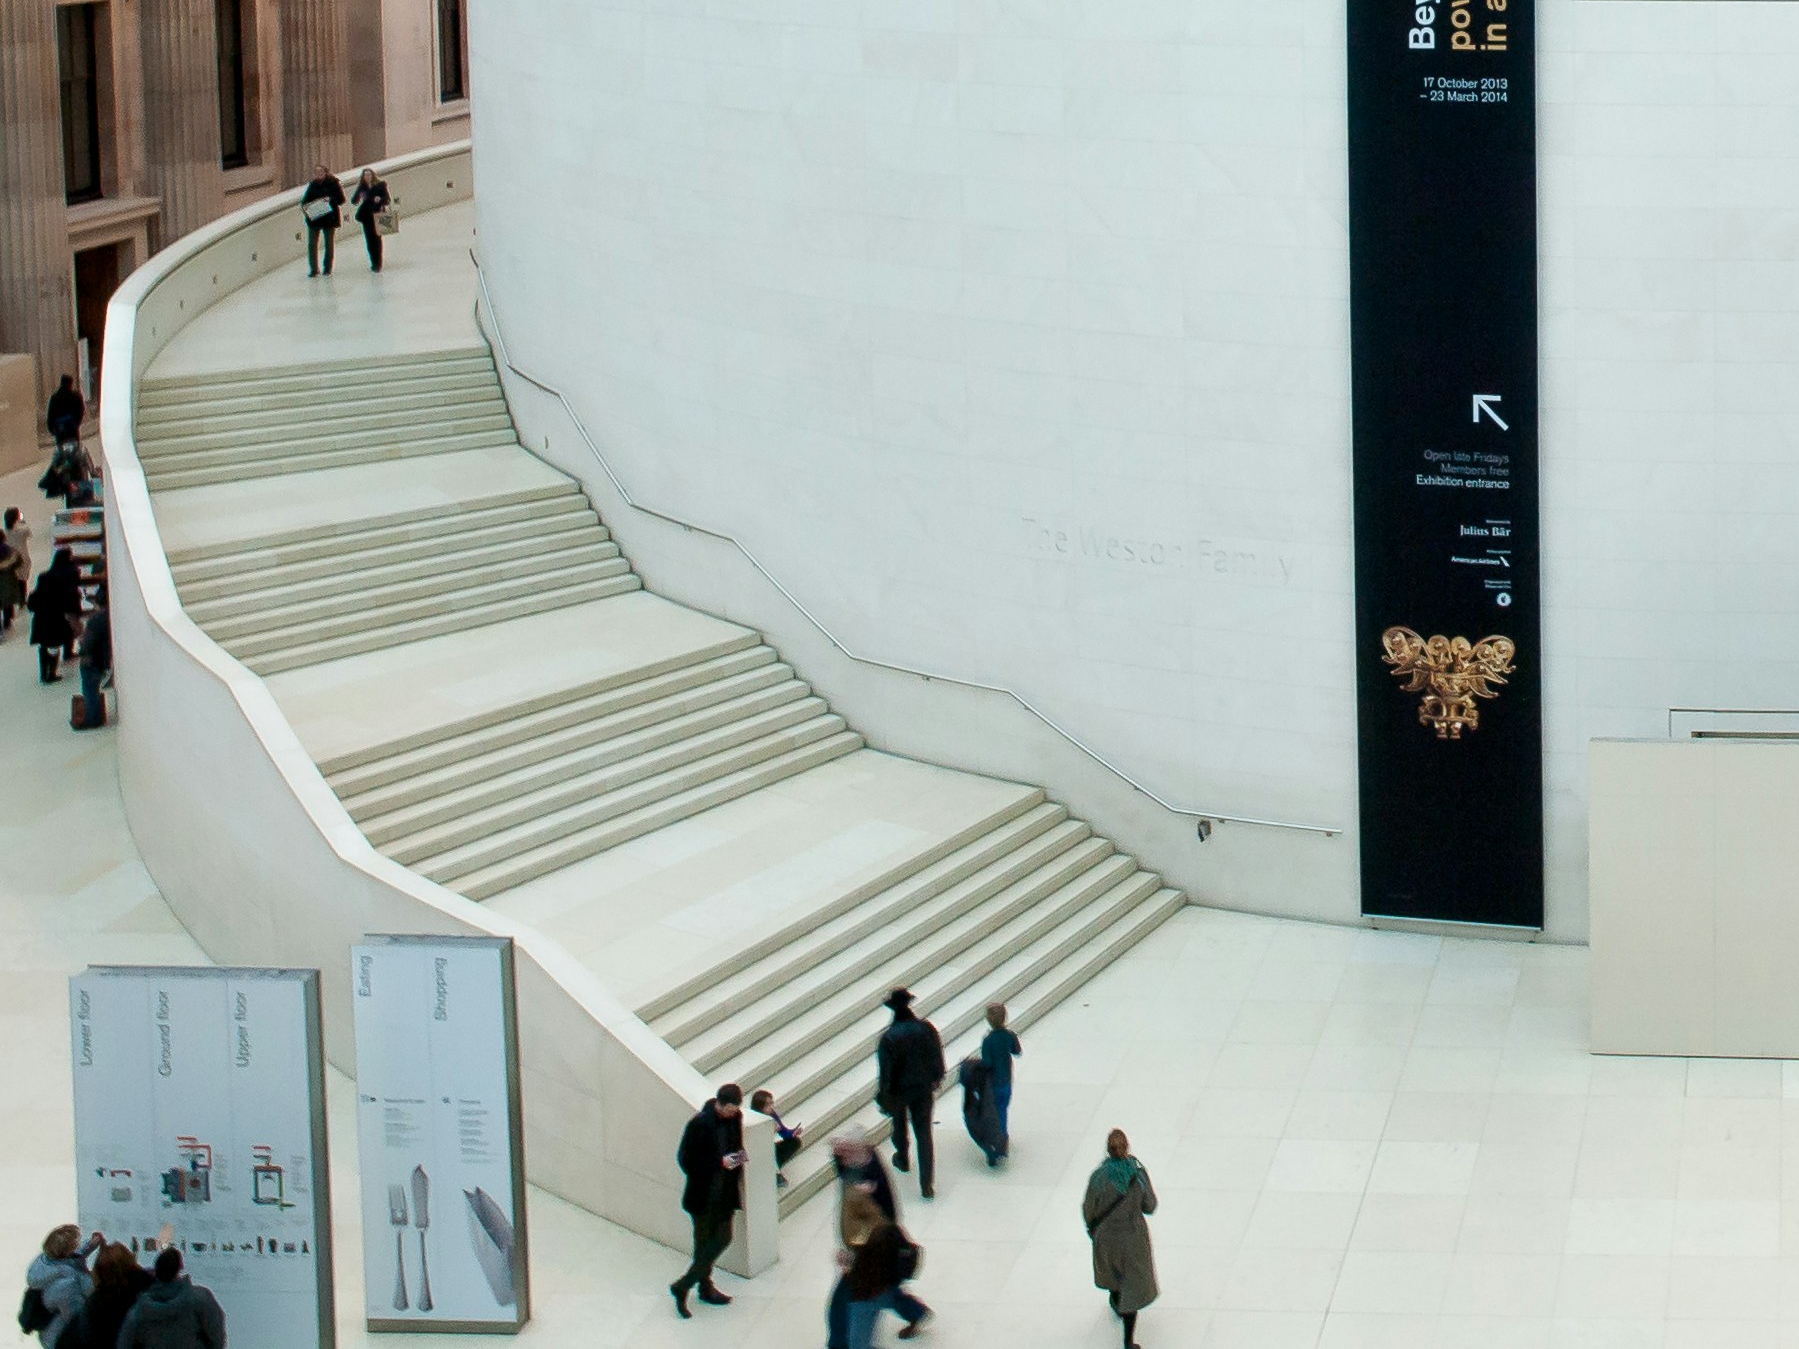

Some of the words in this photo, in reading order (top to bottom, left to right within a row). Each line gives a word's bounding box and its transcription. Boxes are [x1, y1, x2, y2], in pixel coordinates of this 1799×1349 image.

[1481, 24, 1506, 50] in
[1424, 77, 1434, 87] 17
[1438, 77, 1478, 88] October
[1481, 78, 1507, 89] 2013
[1430, 90, 1444, 101] 23
[1447, 91, 1478, 101] March
[1481, 92, 1507, 102] 2014
[1424, 450, 1451, 461] Open
[1454, 451, 1471, 462] late
[1474, 452, 1509, 466] Fridays
[1416, 474, 1463, 486] Exhibition
[1465, 479, 1510, 489] entrance
